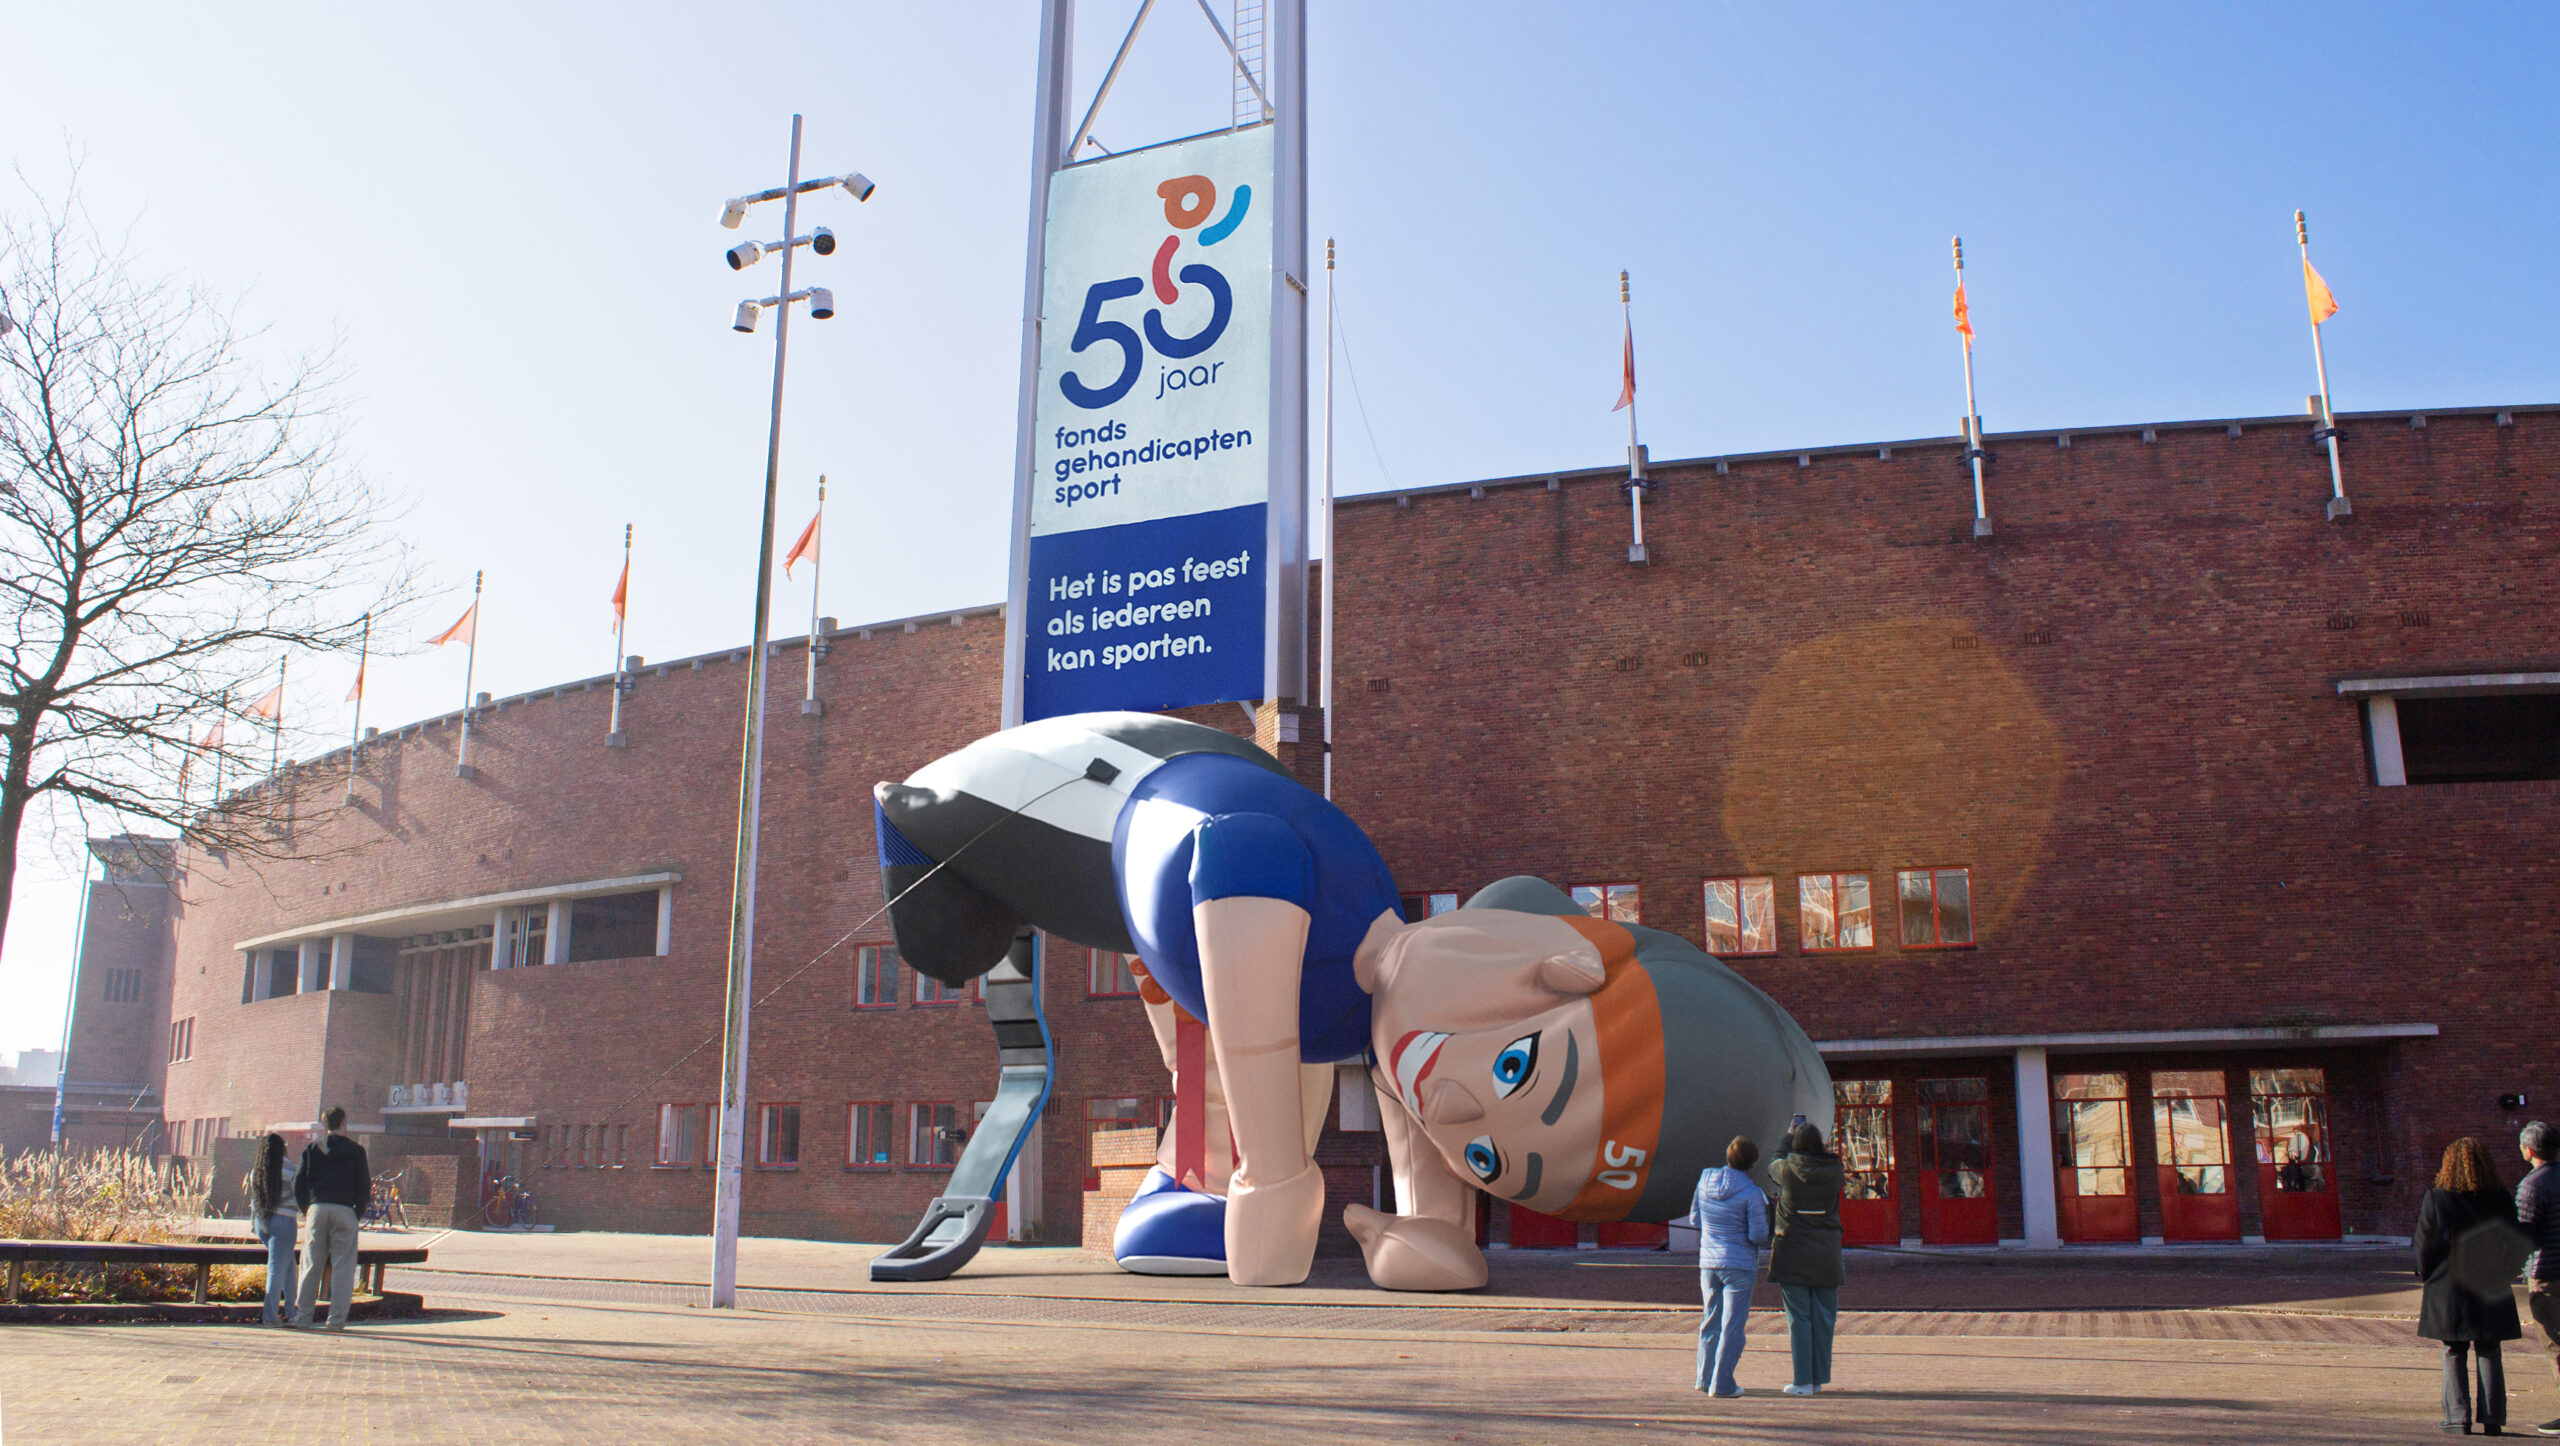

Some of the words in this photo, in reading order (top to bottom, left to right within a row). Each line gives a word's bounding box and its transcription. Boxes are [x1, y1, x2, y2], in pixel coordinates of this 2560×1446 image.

[1059, 264, 1233, 410] 50
[1155, 361, 1225, 400] jaar
[1054, 419, 1127, 450] fonds
[1054, 428, 1252, 483] gehandicapten
[1054, 472, 1122, 508] sport
[1049, 572, 1096, 602] Het
[1101, 569, 1122, 595] is
[1127, 566, 1176, 597] pas
[1181, 549, 1250, 583] feest
[1046, 609, 1085, 636] als
[1091, 597, 1211, 632] iedereen
[1047, 647, 1096, 673] kan
[1101, 632, 1212, 670] sporten.
[1597, 1139, 1647, 1190] 50
